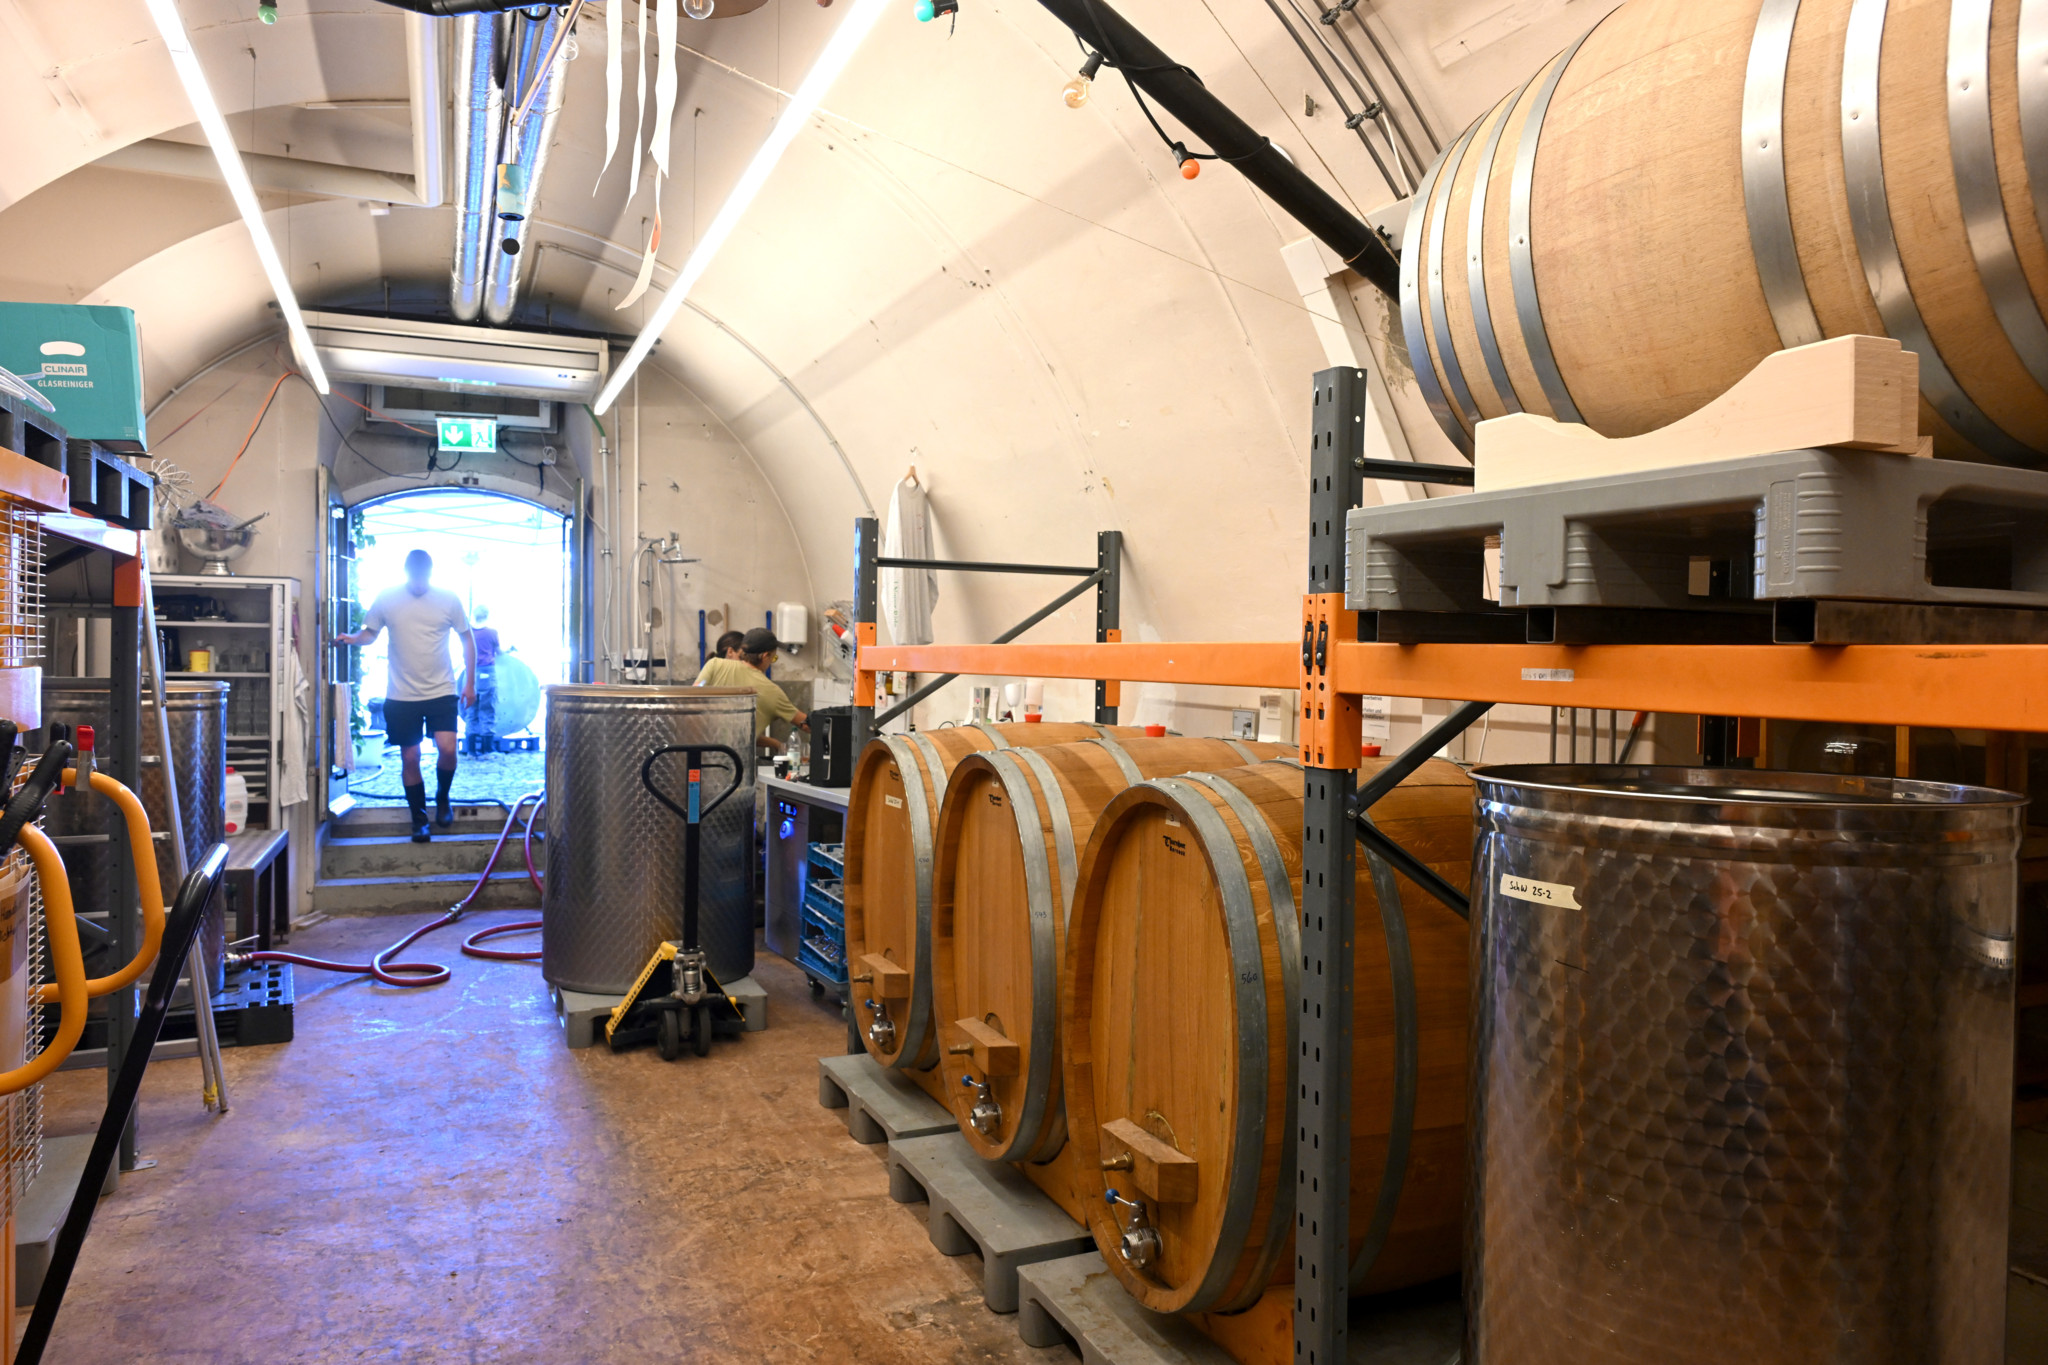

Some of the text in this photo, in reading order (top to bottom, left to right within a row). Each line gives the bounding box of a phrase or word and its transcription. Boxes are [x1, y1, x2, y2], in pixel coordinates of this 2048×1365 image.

[44, 365, 85, 374] CLINAIR
[37, 379, 94, 389] GLASREINIGER
[1170, 814, 1175, 822] 3
[1532, 886, 1552, 900] 25-2
